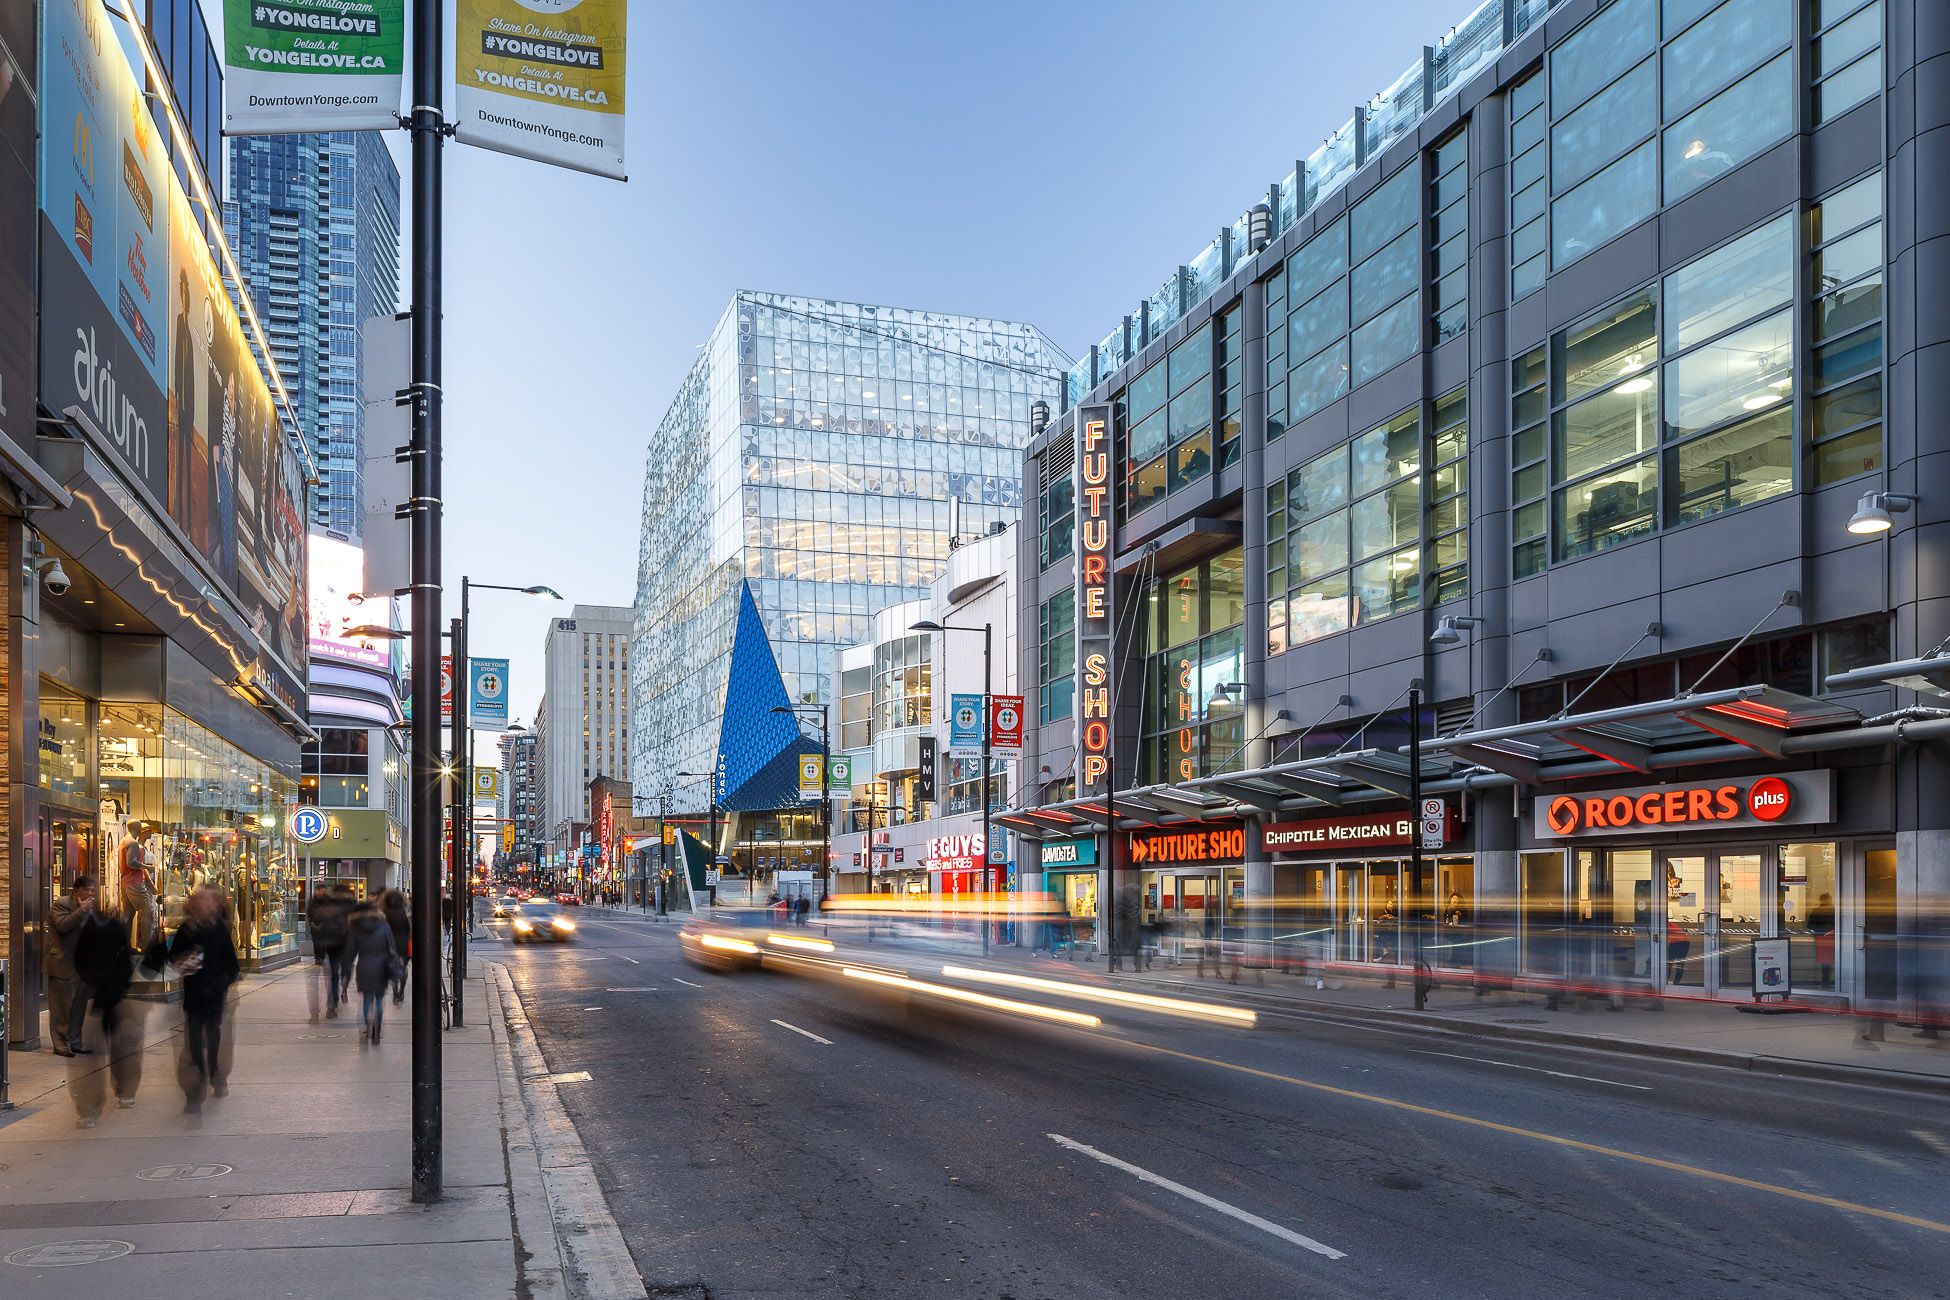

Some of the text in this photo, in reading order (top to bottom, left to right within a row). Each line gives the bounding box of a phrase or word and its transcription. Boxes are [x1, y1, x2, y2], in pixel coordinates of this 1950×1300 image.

[254, 6, 377, 33] #YONGELOVE
[488, 17, 597, 46] Share On Instagram
[244, 45, 386, 68] YONGELOVE.CA
[293, 37, 339, 51] Details At
[485, 35, 600, 66] #YONGELOVE
[475, 68, 609, 105] YONGELOVE.CA
[520, 65, 563, 81] Details At
[249, 94, 379, 107] DowntownYonge.com
[478, 109, 604, 148] DowntownYonge.com
[74, 325, 149, 480] atrium
[1083, 419, 1108, 786] FUTURE SHOP
[558, 619, 577, 631] 415
[718, 753, 726, 796] Yonge
[922, 748, 932, 791] HMV
[1585, 786, 1785, 829] ROGERS plus
[940, 833, 985, 858] GUYS
[1149, 832, 1207, 862] FUTURE
[1265, 828, 1325, 845] CHIPOTLE
[1328, 824, 1390, 841] MEXICAN
[953, 856, 973, 870] FRIES
